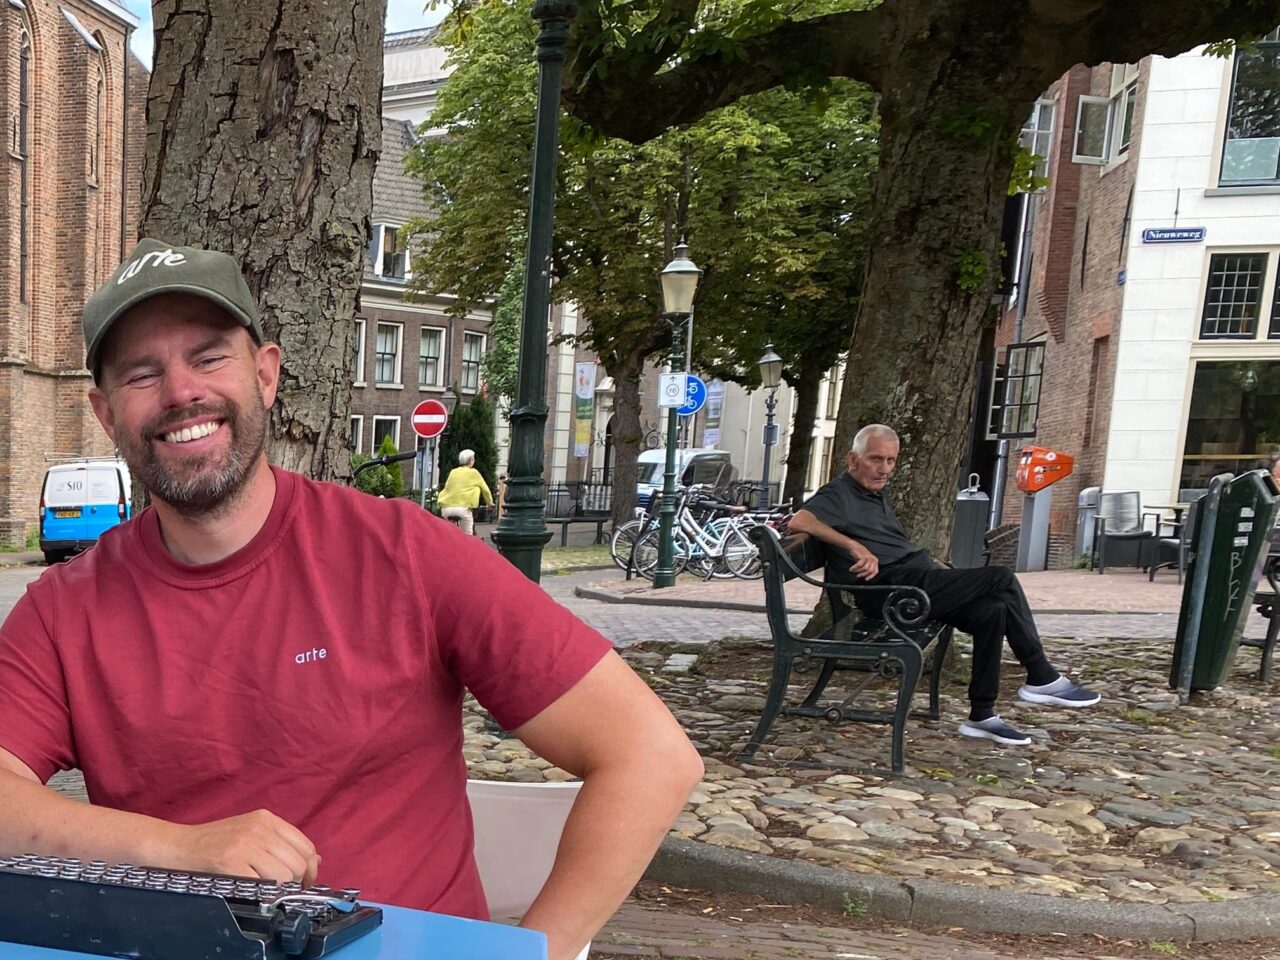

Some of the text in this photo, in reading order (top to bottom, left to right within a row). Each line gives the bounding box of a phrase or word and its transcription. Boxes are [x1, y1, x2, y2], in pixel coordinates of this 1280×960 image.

[1148, 230, 1201, 240] Nieuweweg
[116, 248, 187, 285] arte
[294, 647, 327, 664] arte
